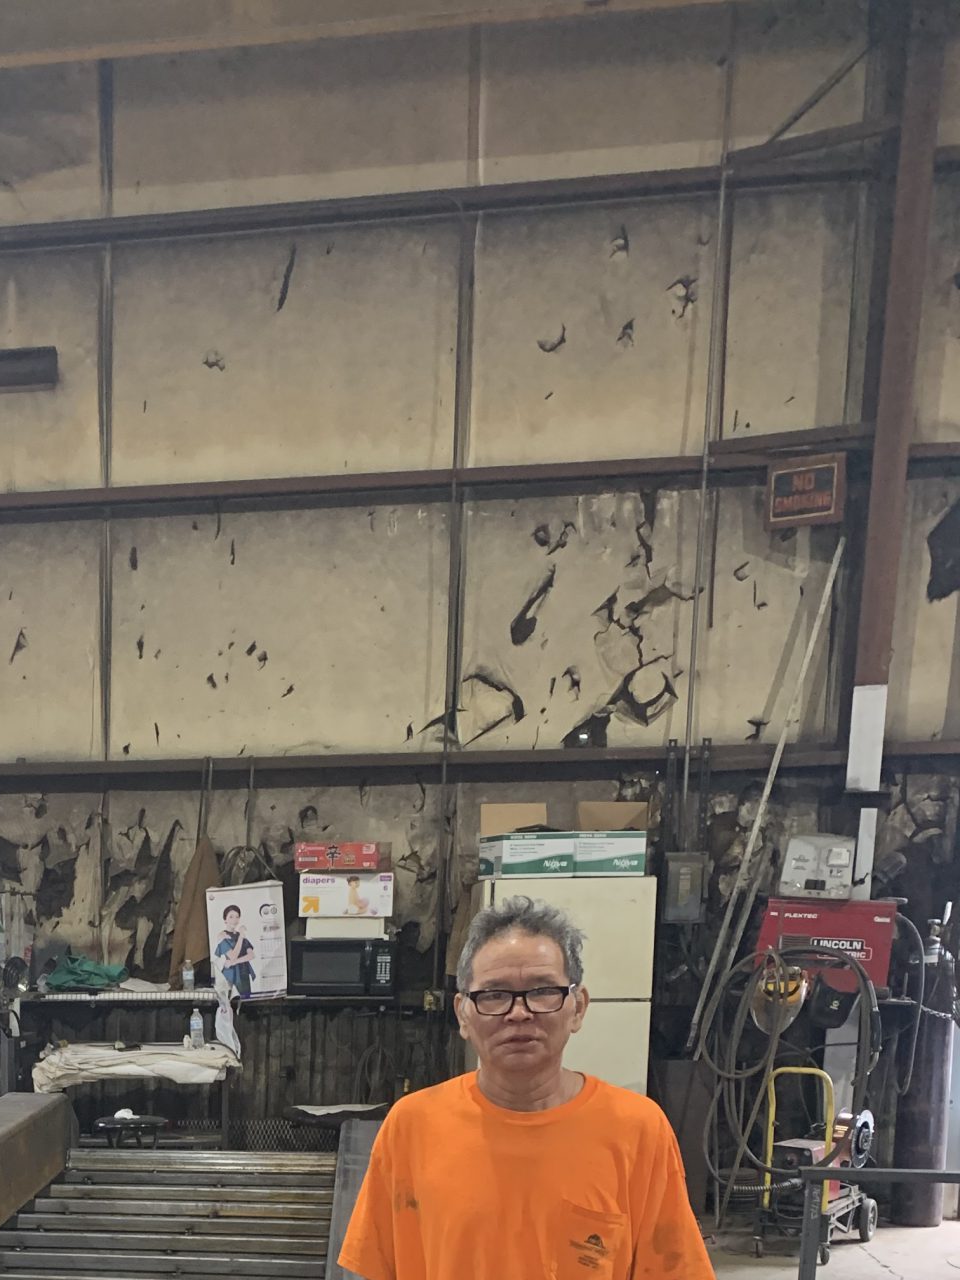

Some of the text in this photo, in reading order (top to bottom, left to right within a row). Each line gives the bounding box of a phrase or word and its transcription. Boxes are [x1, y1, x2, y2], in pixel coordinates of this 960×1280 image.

[792, 473, 815, 491] NO
[302, 877, 336, 885] diapers
[813, 939, 862, 950] LINCOLN
